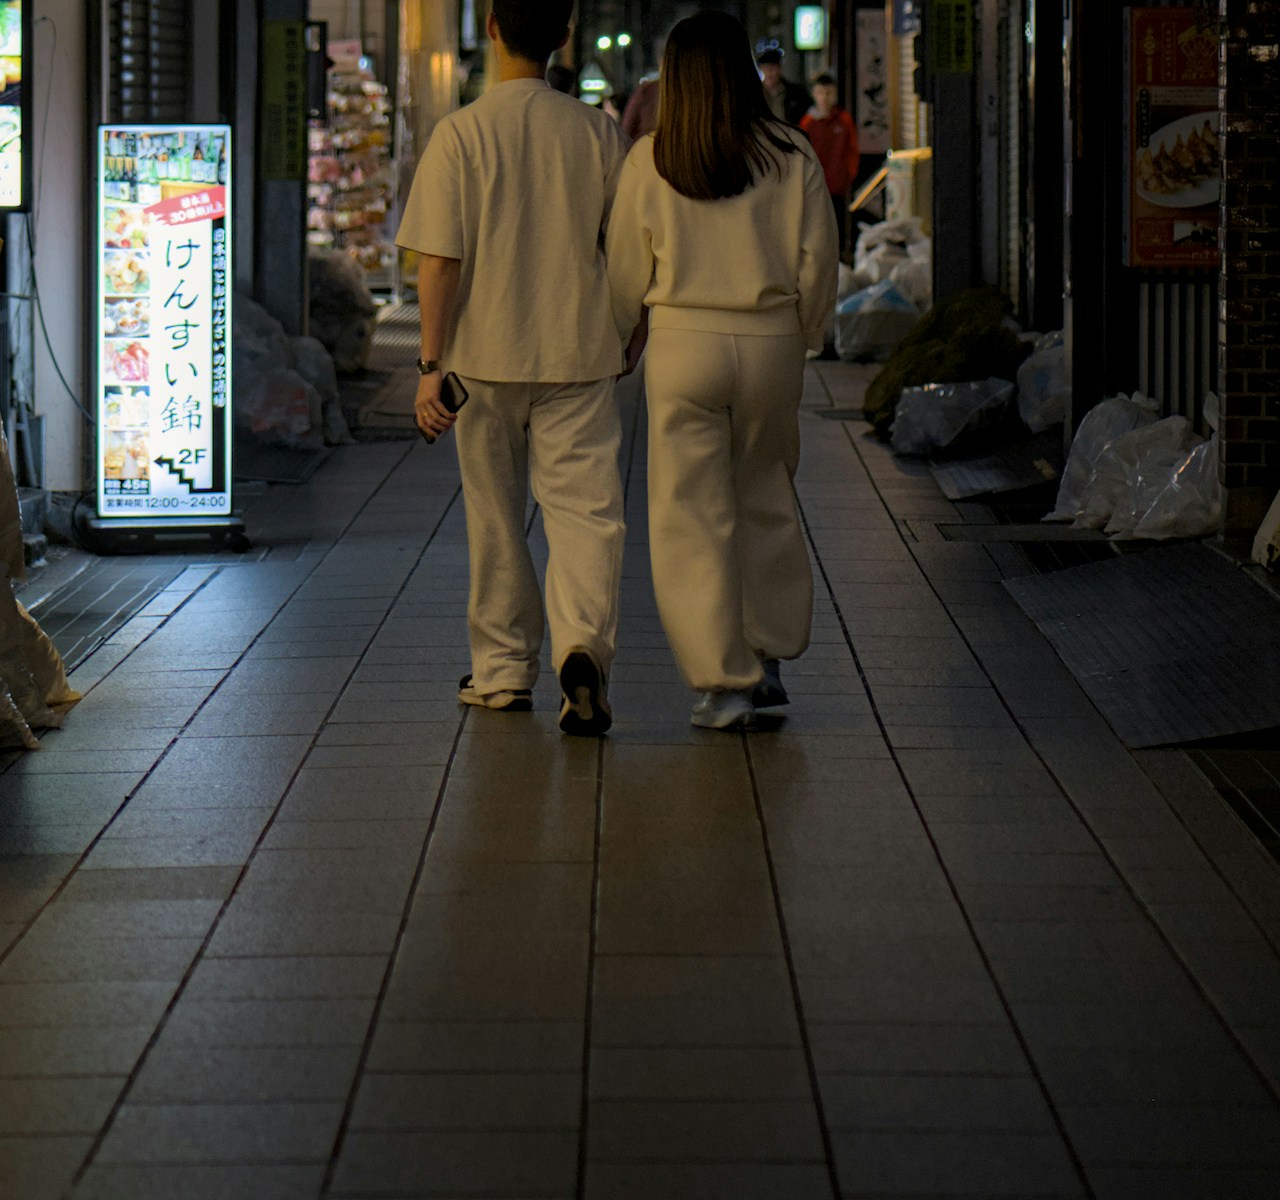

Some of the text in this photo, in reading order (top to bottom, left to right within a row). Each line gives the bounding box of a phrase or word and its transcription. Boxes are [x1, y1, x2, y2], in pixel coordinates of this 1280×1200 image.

[159, 236, 204, 436] けんすい錦
[178, 448, 208, 465] 2F
